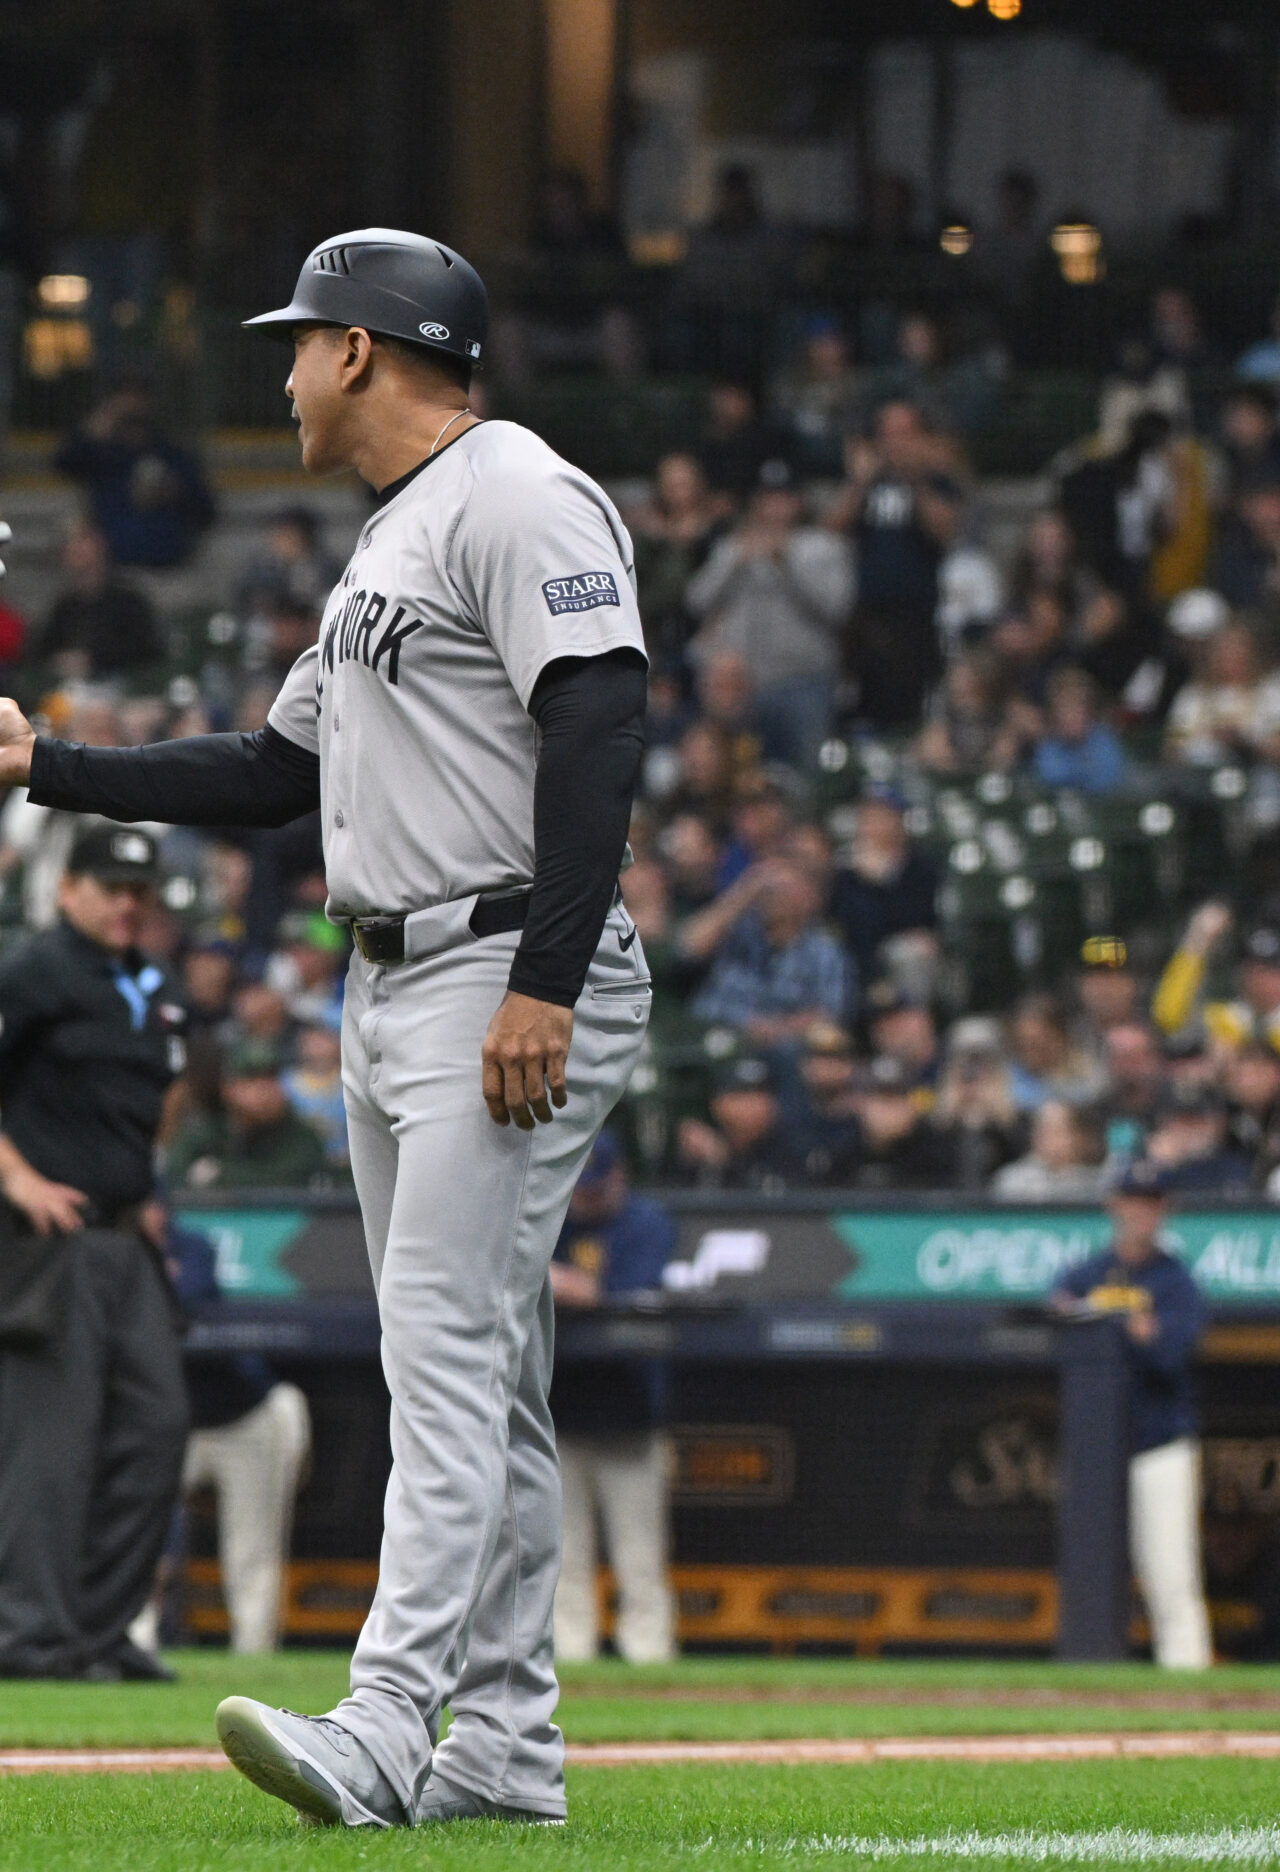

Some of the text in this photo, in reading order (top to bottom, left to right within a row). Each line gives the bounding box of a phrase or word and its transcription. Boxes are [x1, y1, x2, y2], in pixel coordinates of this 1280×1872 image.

[546, 574, 615, 600] STARR
[554, 595, 617, 612] INSURANCE
[339, 589, 425, 686] YORK
